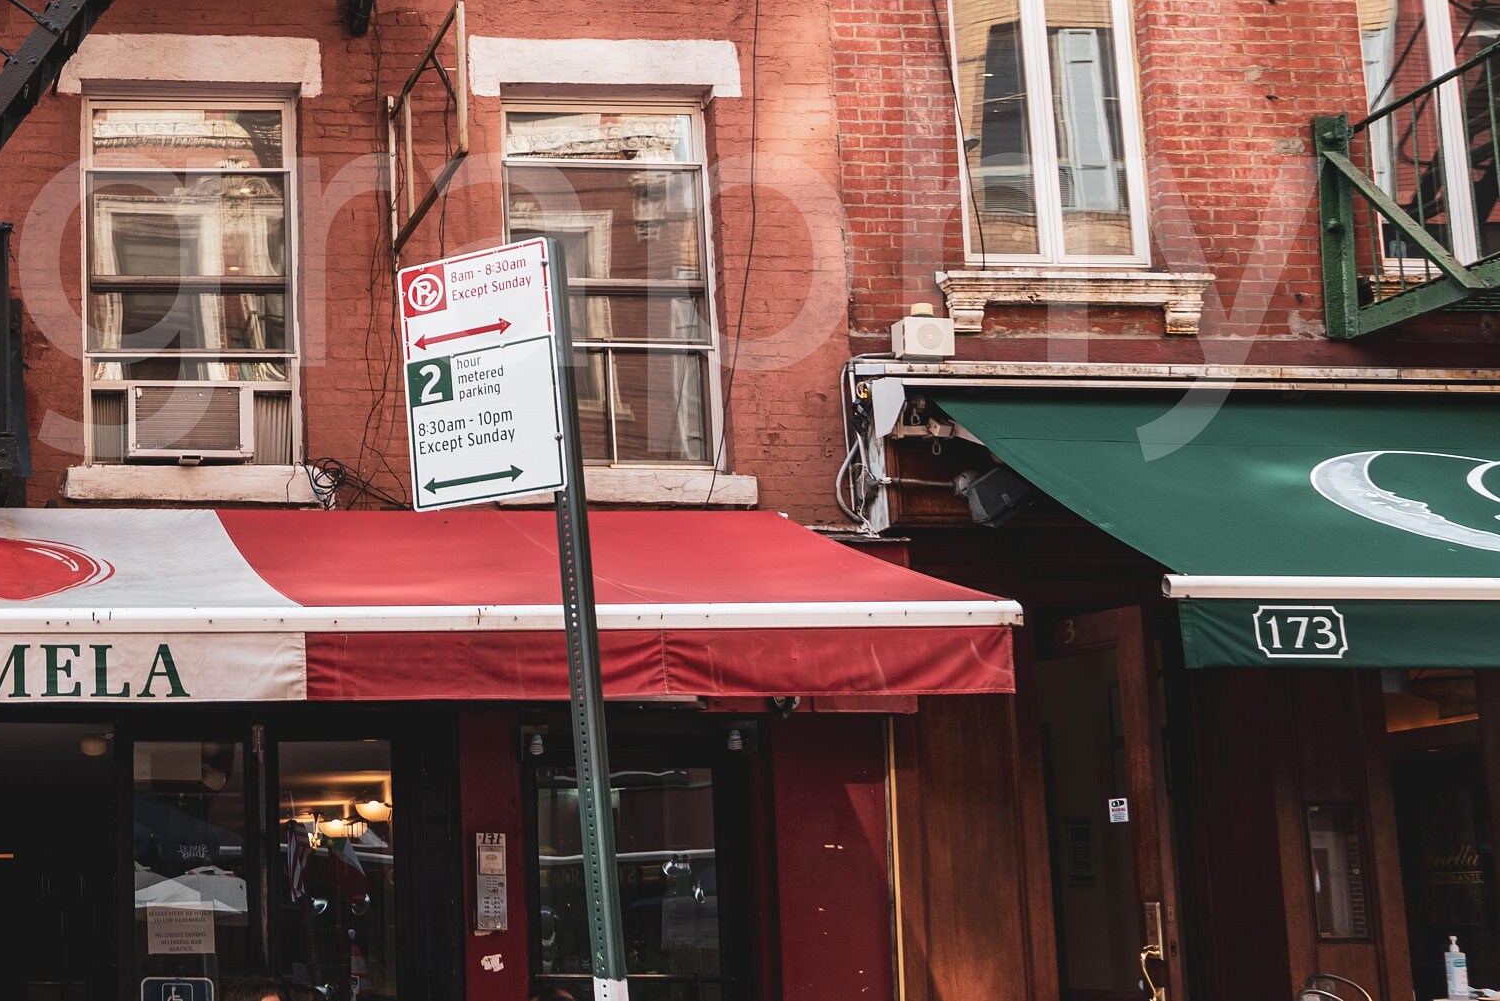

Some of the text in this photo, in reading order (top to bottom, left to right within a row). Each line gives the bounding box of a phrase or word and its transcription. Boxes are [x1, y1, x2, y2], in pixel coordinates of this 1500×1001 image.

[450, 269, 474, 284] 8am
[485, 257, 527, 276] 8:30am
[451, 274, 532, 302] Except Sunday
[456, 356, 482, 370] hour
[457, 364, 504, 385] metered
[418, 363, 443, 404] 2
[459, 382, 501, 402] parking
[418, 418, 466, 437] 8:30am
[478, 409, 513, 427] 10pm
[419, 428, 515, 455] Except Sunday
[1265, 615, 1338, 650] 173
